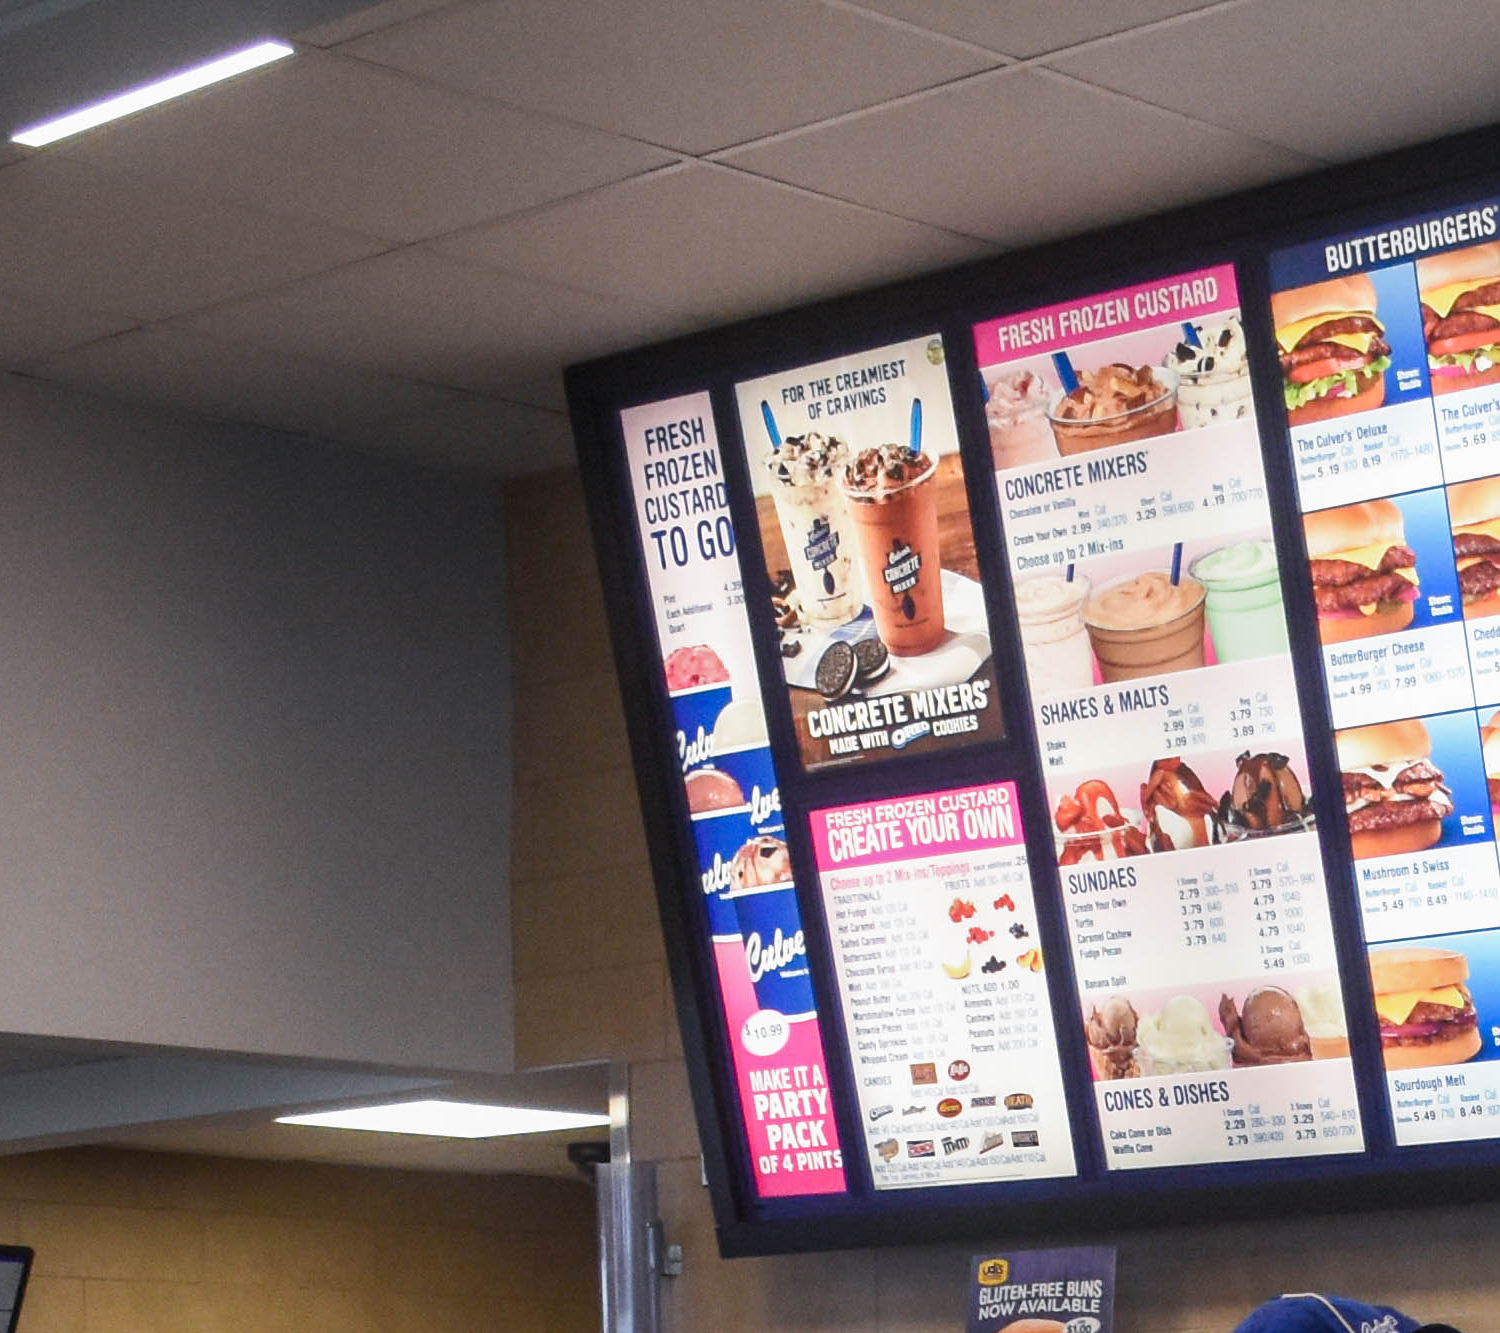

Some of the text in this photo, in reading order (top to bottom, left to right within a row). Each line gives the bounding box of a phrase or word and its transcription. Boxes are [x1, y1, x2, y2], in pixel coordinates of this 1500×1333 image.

[998, 279, 1217, 351] FRESH FROZEN CUSTARD
[782, 361, 906, 405] FOR THE CREAMIEST
[809, 388, 887, 420] OF CRAVINGS
[645, 421, 705, 455] FRESH
[645, 455, 718, 489] FROZEN
[1005, 464, 1083, 500] CONCRETE
[645, 483, 729, 524] CUSTARD
[651, 521, 735, 570] TO GO
[807, 698, 907, 739] CONCRETE
[1041, 686, 1169, 725] SHAKES & MALTS
[830, 715, 978, 753] MADE WITH OREO COOKIES
[825, 788, 1008, 829] FRESH FROZEN CUSTARD
[827, 806, 1014, 862] CREATE YOUR OWN
[1068, 866, 1137, 895] SUNDAES
[749, 1065, 824, 1093] MAKE IT A
[1104, 1081, 1229, 1111] CONES & DISHES
[754, 1087, 828, 1121] PARTY
[767, 1120, 828, 1152] PACK
[759, 1149, 842, 1175] OF 4 PINTS
[979, 1280, 1102, 1305] GLUTEN-FREE BUNS
[979, 1297, 1100, 1320] NOW AVAILABLE
